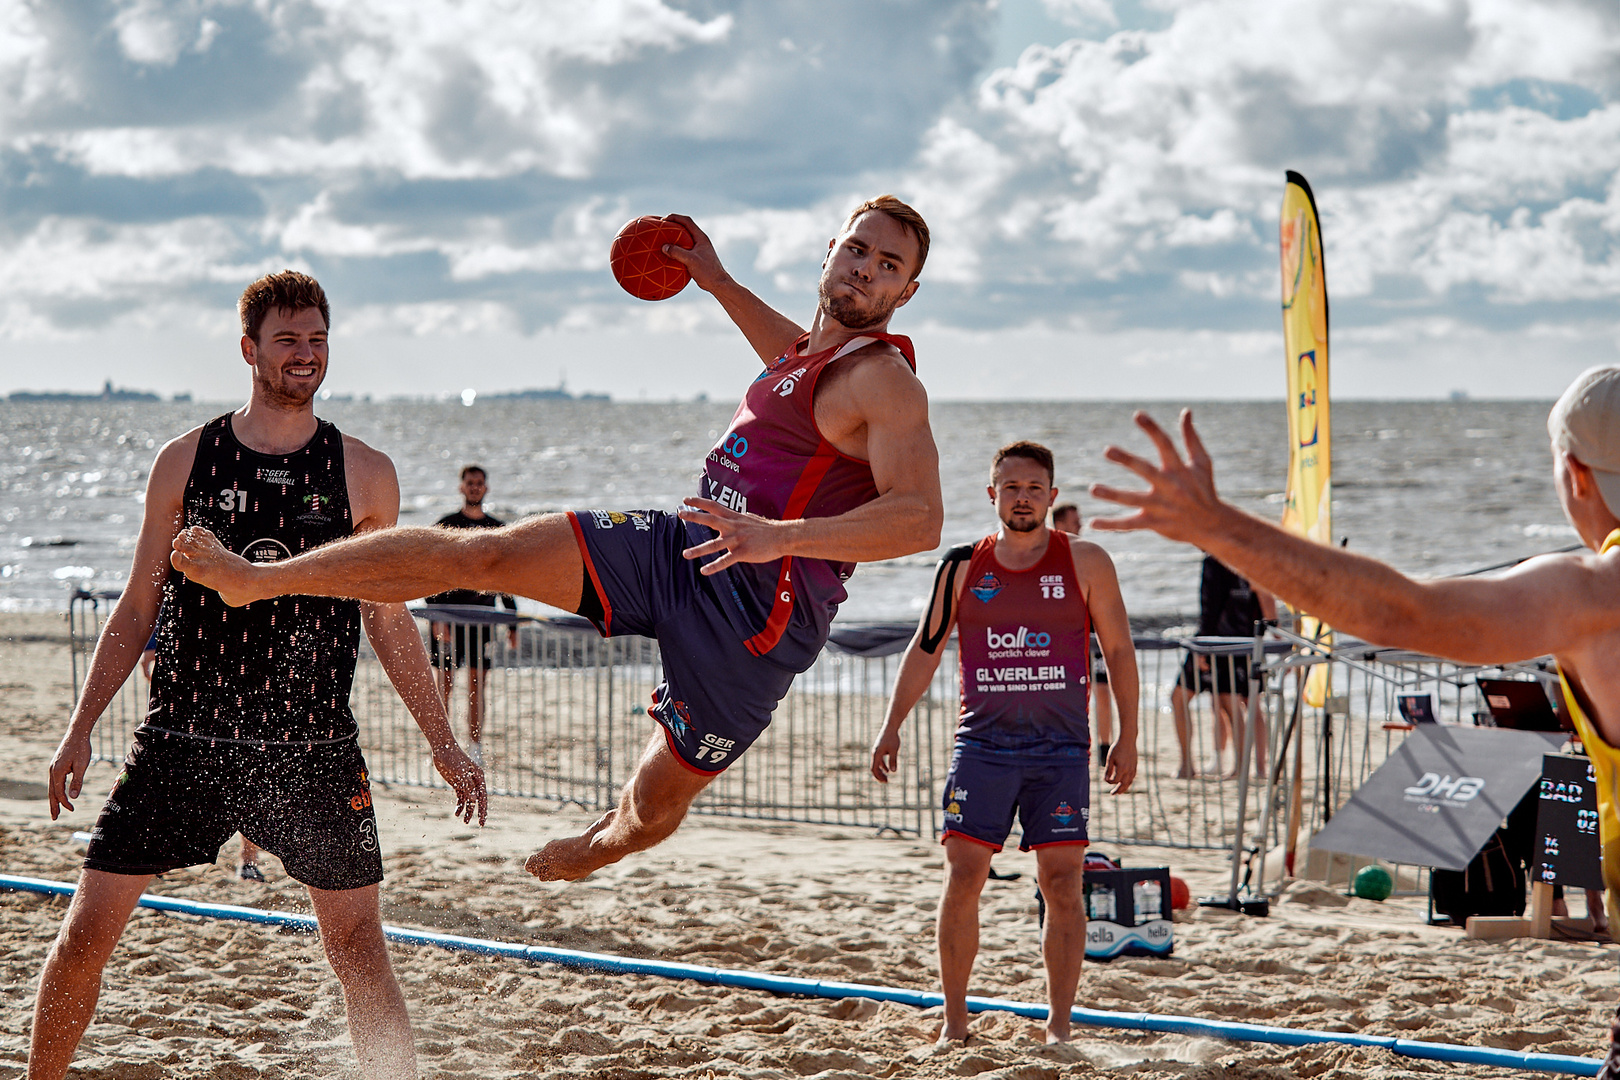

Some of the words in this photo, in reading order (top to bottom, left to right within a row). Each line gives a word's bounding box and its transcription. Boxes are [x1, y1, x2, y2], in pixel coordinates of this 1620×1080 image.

[772, 377, 795, 397] 19
[266, 477, 295, 486] HANDBALL
[219, 488, 248, 512] 31
[708, 477, 747, 515] LEIH
[1039, 575, 1063, 583] GER
[1041, 586, 1066, 599] 18
[987, 626, 1051, 649] ballco
[988, 649, 1023, 660] sportlich
[1024, 648, 1050, 658] clever
[989, 684, 1006, 692] WIR
[1007, 683, 1027, 692] SIND
[1028, 683, 1042, 691] IST
[1043, 682, 1066, 691] OBEN
[704, 733, 736, 748] GER
[695, 745, 728, 764] 19
[1404, 772, 1486, 801] DHB
[1147, 925, 1168, 938] hella
